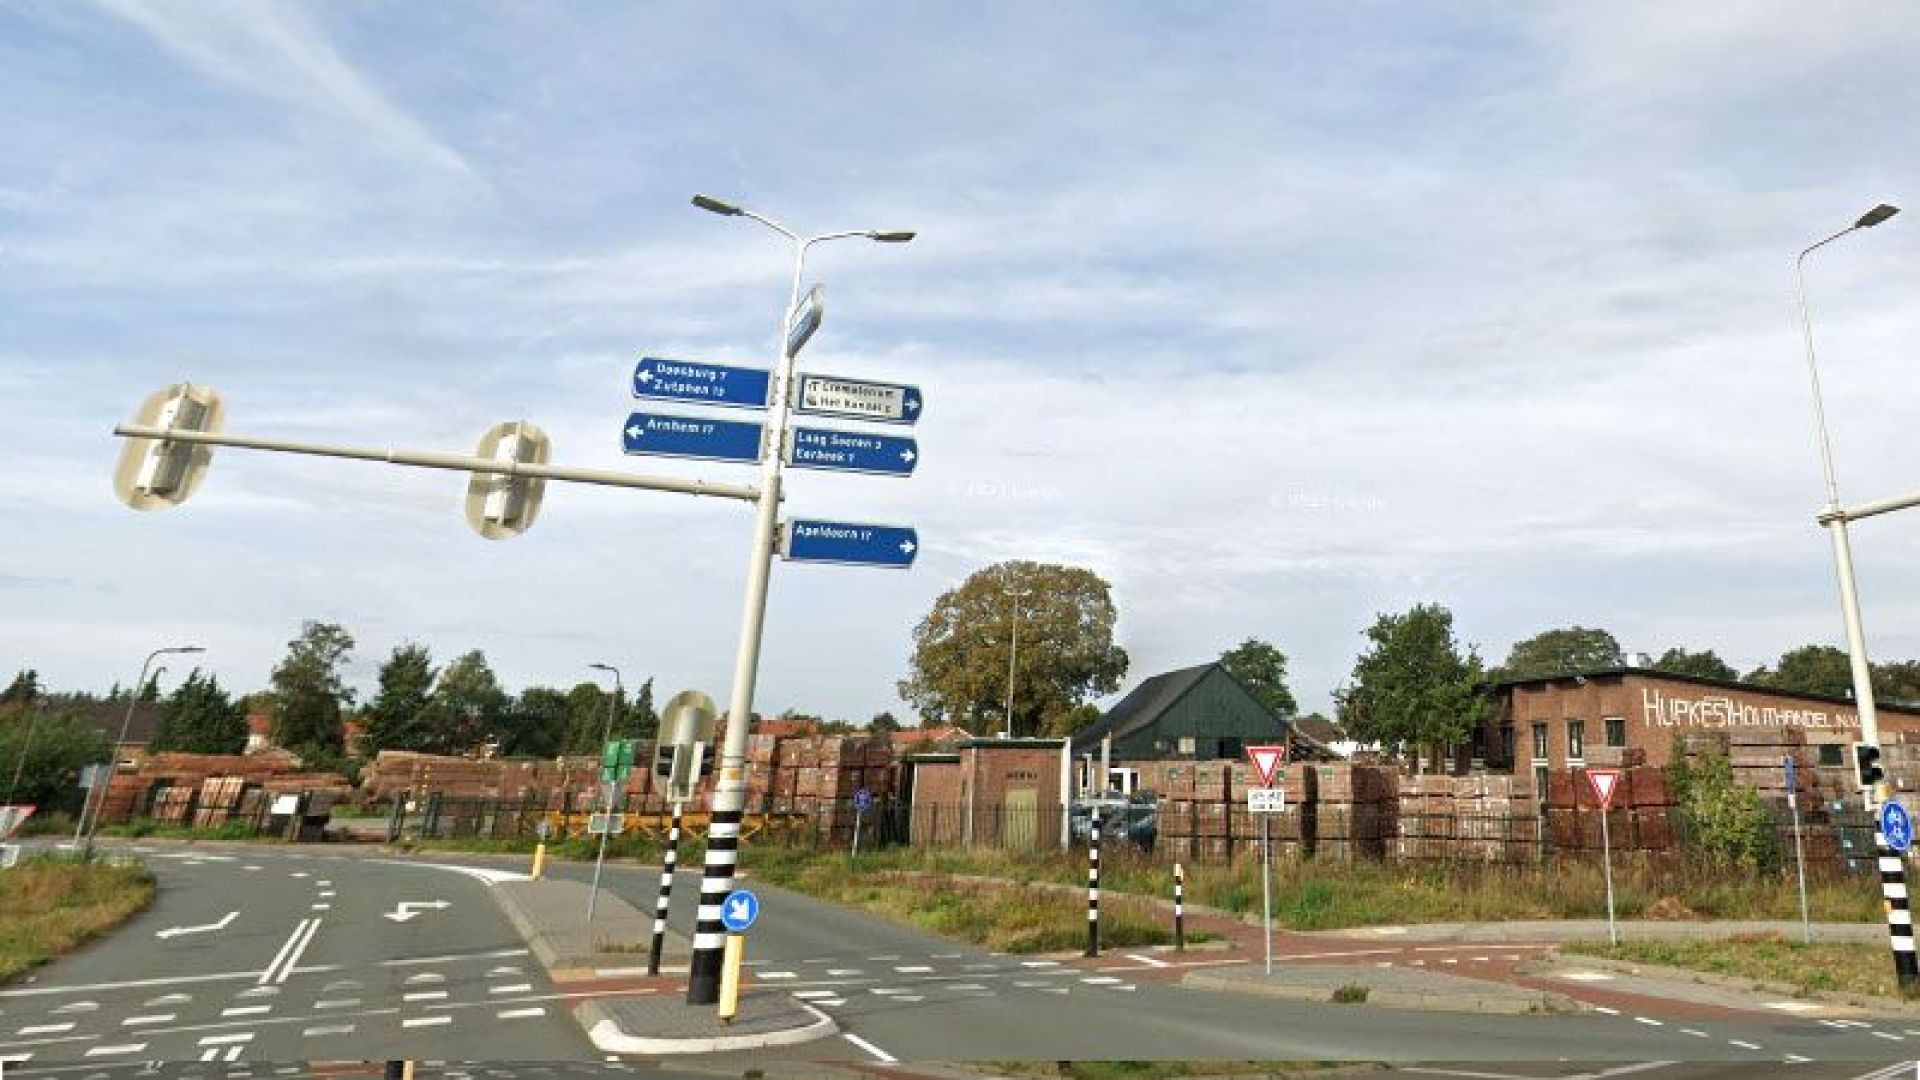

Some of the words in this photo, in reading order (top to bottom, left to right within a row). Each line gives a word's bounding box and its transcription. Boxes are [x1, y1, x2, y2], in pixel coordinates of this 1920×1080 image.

[654, 378, 709, 395] Zutphen
[647, 418, 699, 433] Arnhem
[796, 525, 857, 539] Apeldoorn
